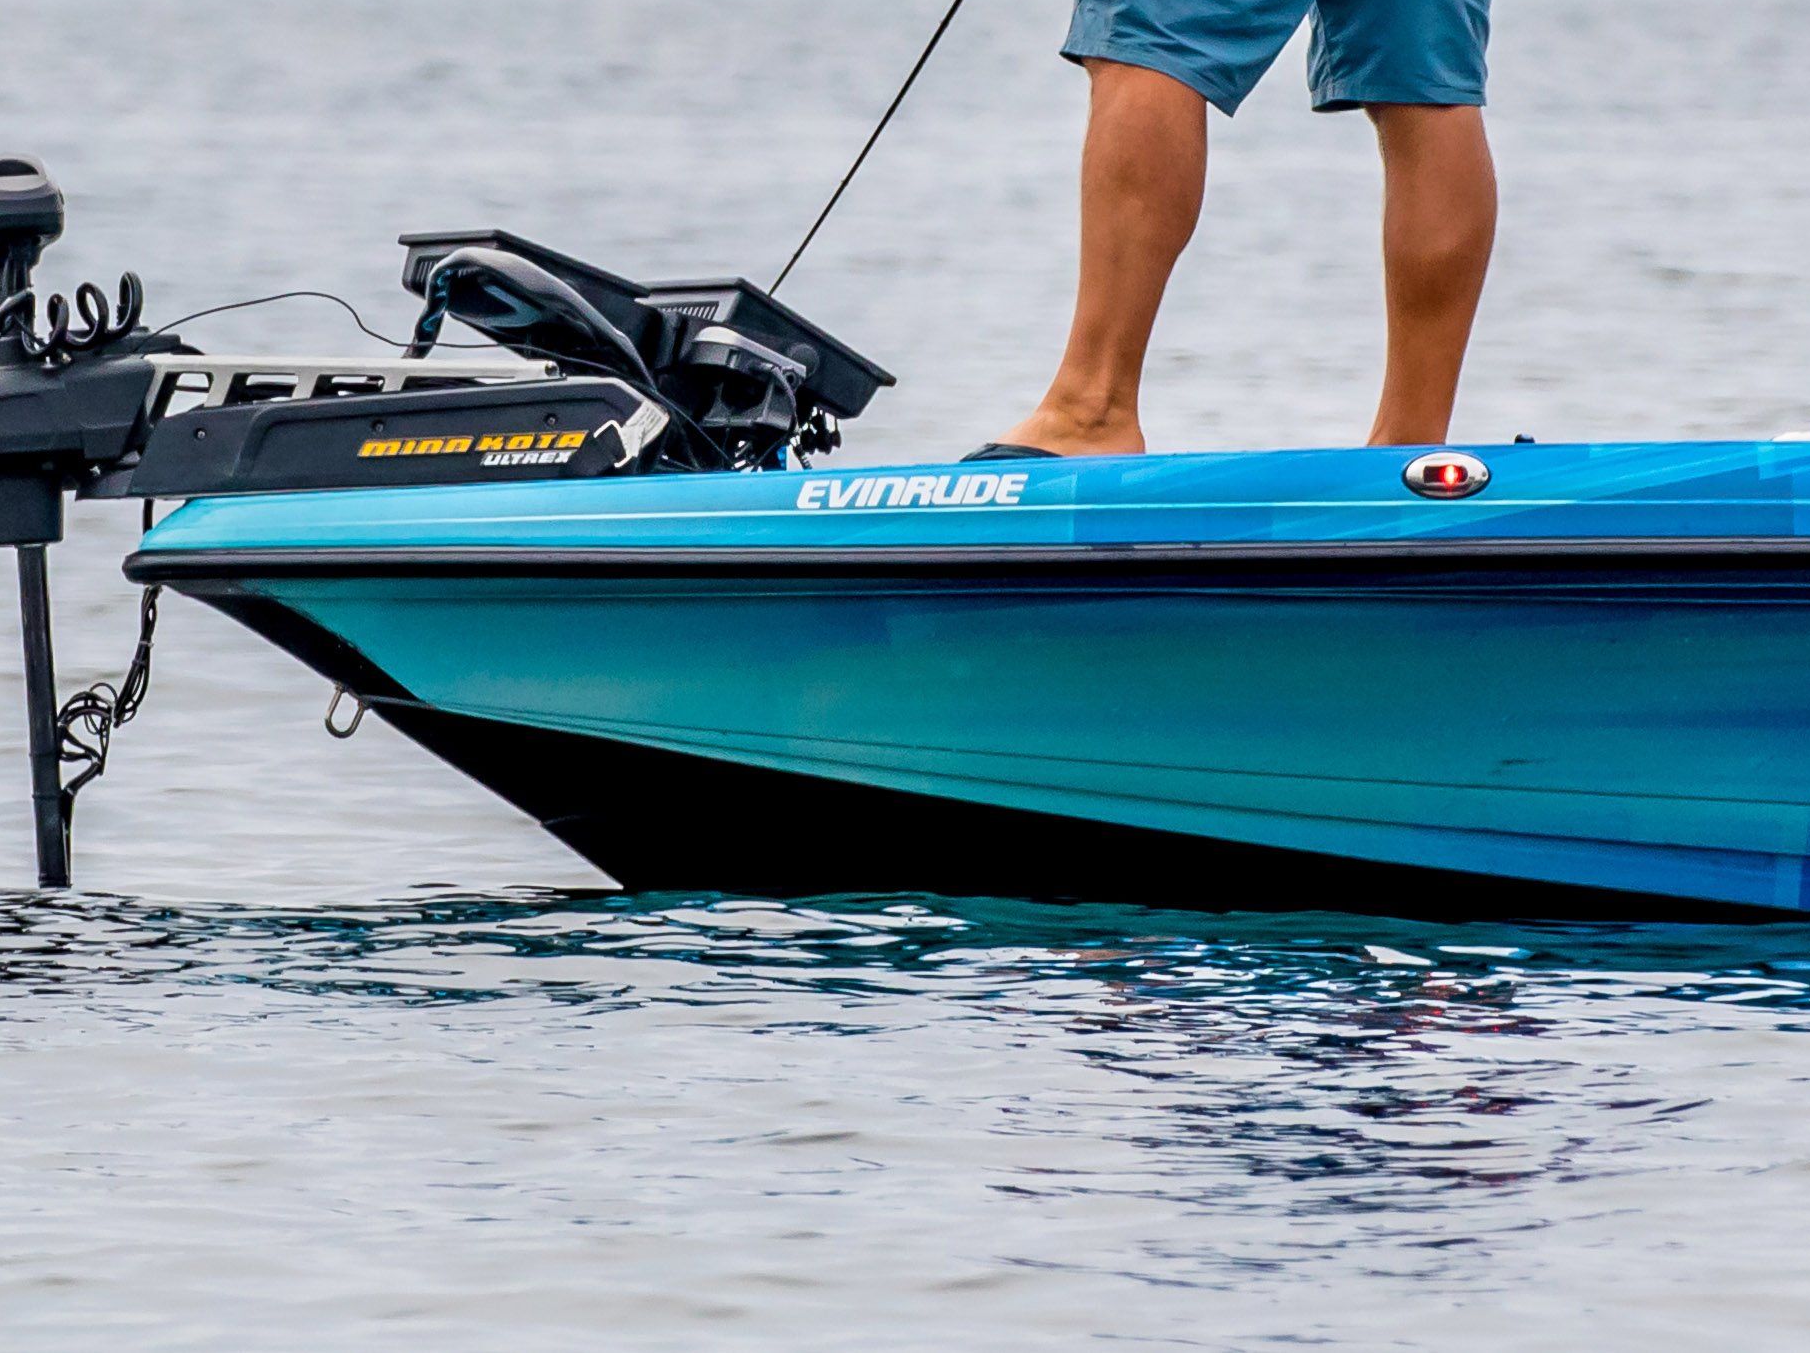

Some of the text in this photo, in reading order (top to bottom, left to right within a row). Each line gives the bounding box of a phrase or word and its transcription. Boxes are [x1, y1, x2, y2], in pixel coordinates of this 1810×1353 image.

[357, 430, 589, 457] MINN KOTA
[480, 449, 577, 467] ULTREX
[796, 473, 1029, 510] EVINRUDE
